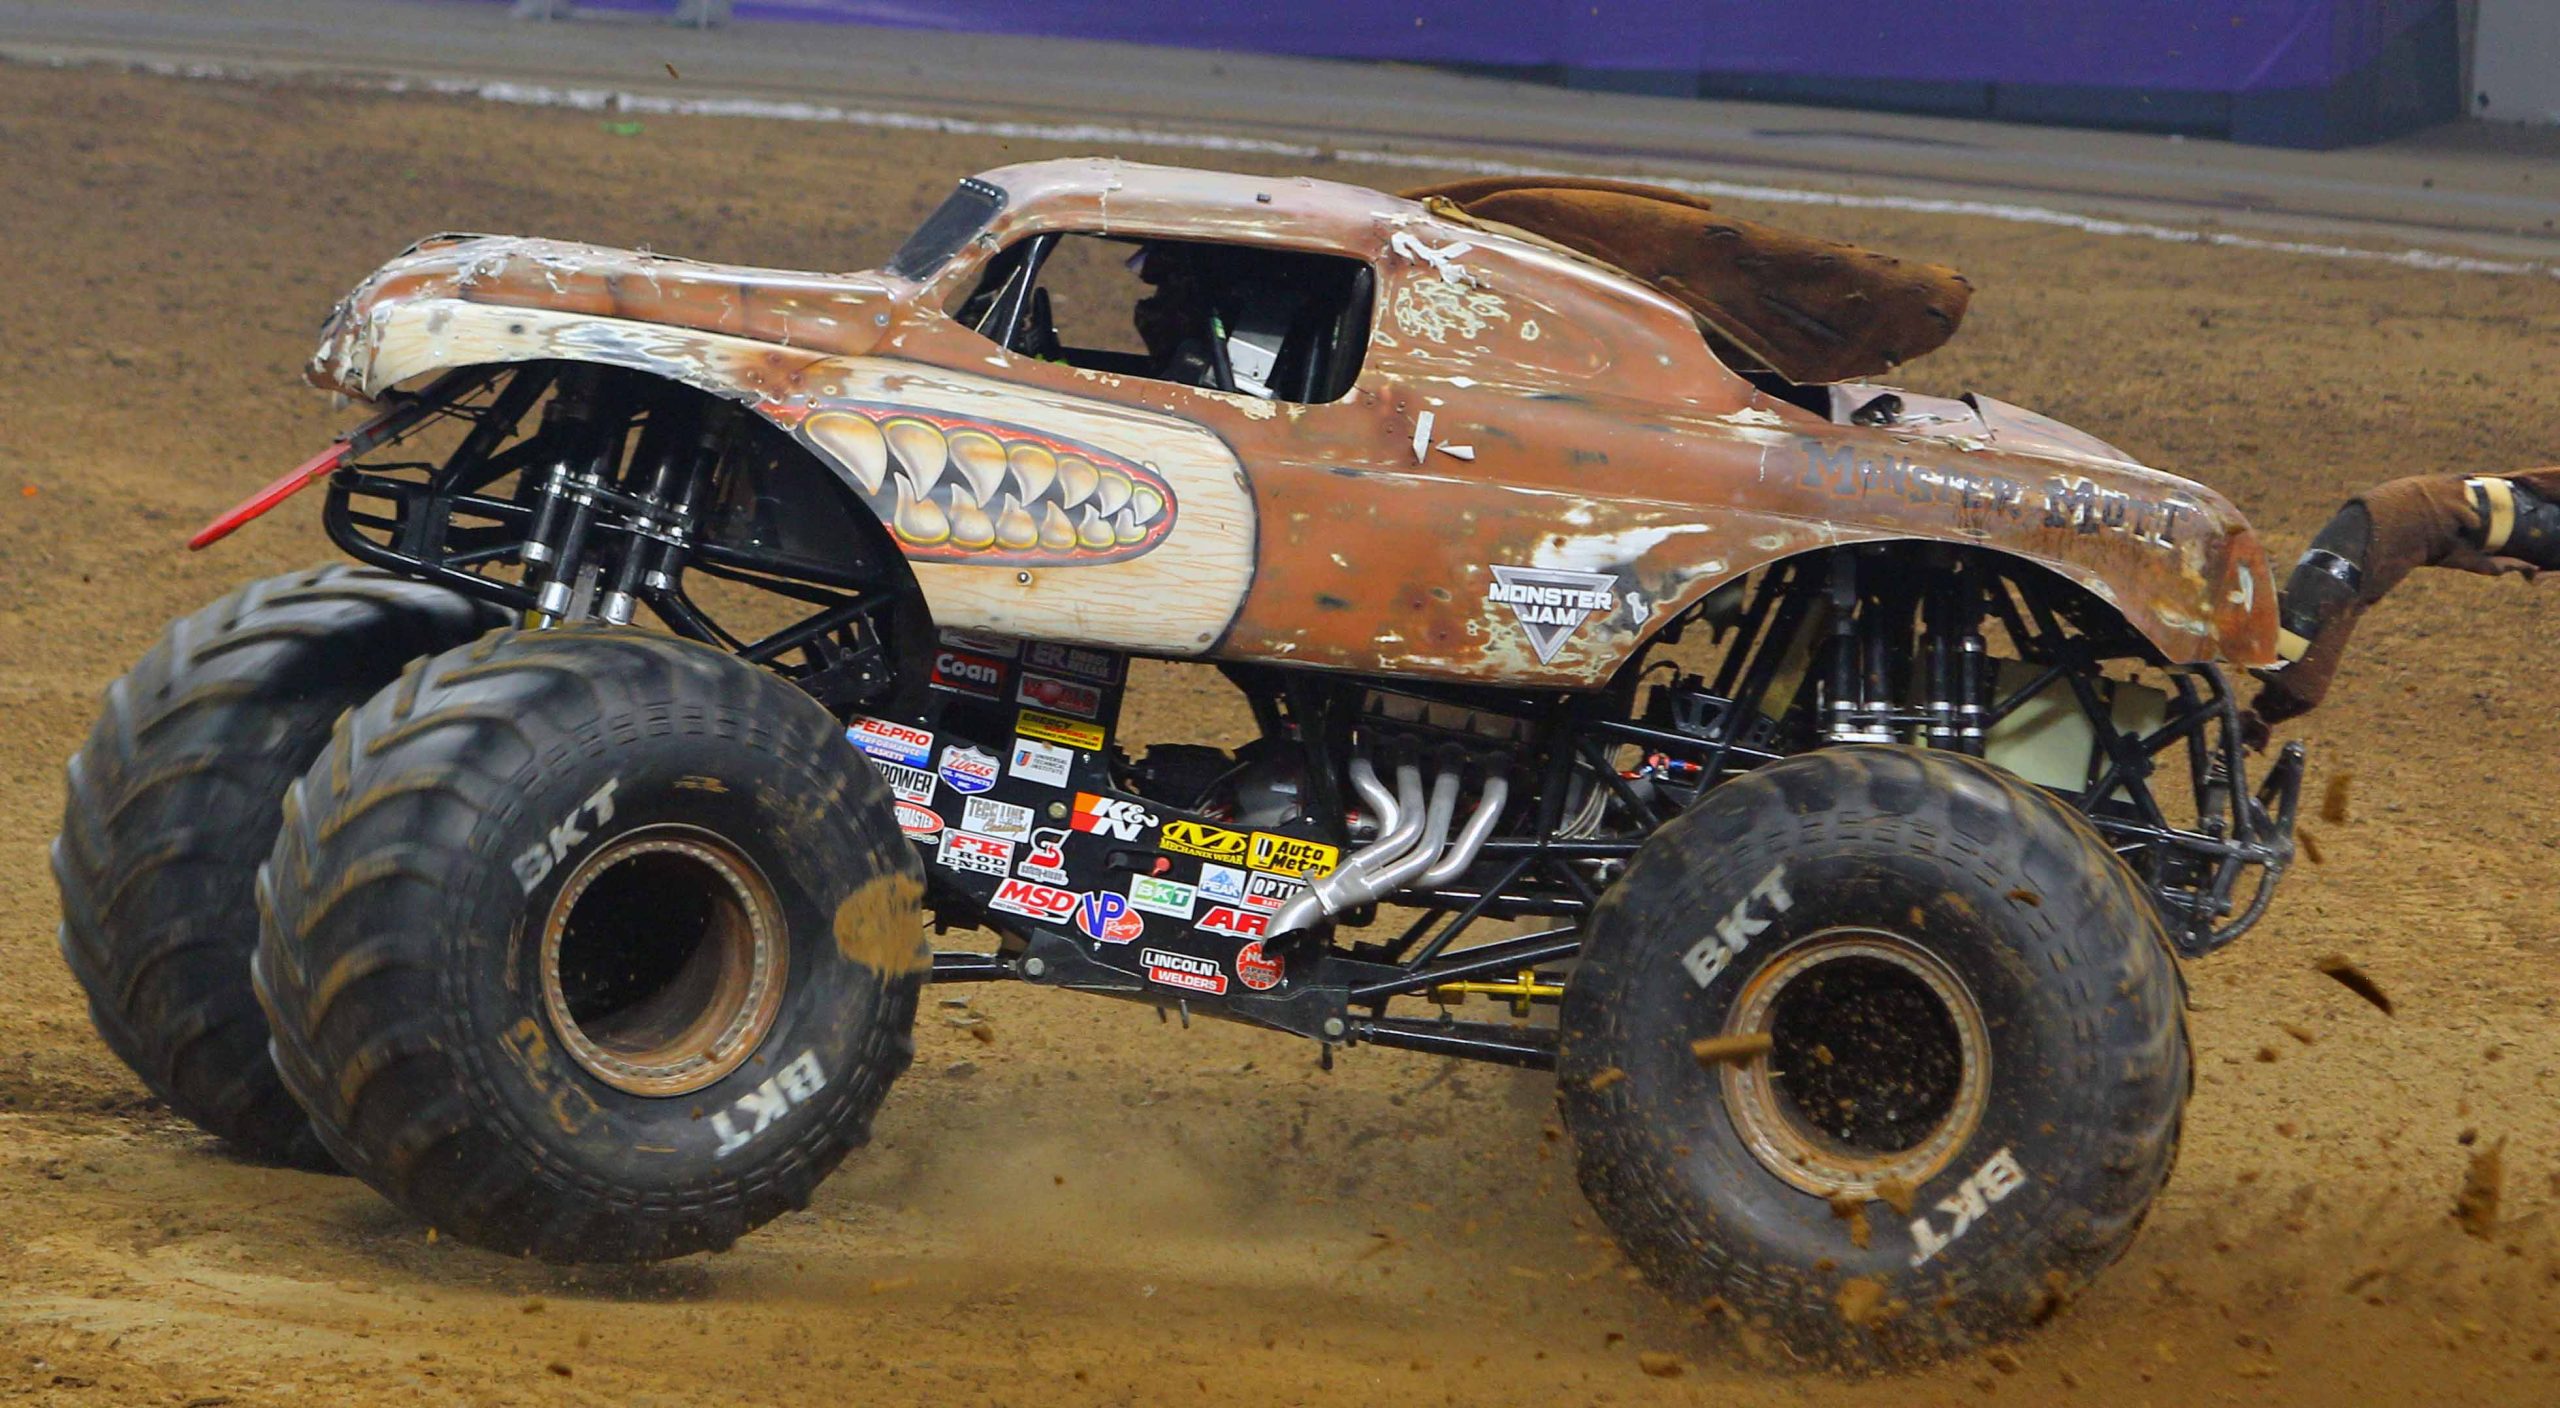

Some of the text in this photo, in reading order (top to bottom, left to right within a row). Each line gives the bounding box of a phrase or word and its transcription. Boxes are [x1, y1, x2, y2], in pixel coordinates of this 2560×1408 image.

[1488, 583, 1613, 610] MONSTER
[1521, 605, 1578, 626] JAM
[936, 653, 998, 684] Coan
[849, 718, 930, 747] FEL-PRO
[874, 762, 934, 795] POWER
[948, 756, 994, 777] LUCAS
[511, 777, 619, 894] BKT
[951, 835, 1010, 858] FK
[958, 851, 1006, 867] ROD
[1160, 837, 1244, 865] MECHANIX WEAR
[1276, 841, 1325, 860] Auto
[942, 856, 1006, 876] ENDS
[999, 881, 1076, 912] MSD
[1136, 880, 1192, 907] BKT
[1202, 880, 1240, 898] PEAK
[1253, 877, 1303, 900] OPTI
[1084, 892, 1126, 939] VP
[1202, 909, 1270, 936] AR
[1681, 863, 1795, 989] BKT
[1145, 952, 1214, 977] LINCOLN
[1158, 969, 1218, 991] WELDERS
[710, 1049, 827, 1159] BKT
[1908, 1147, 2026, 1268] BKT
